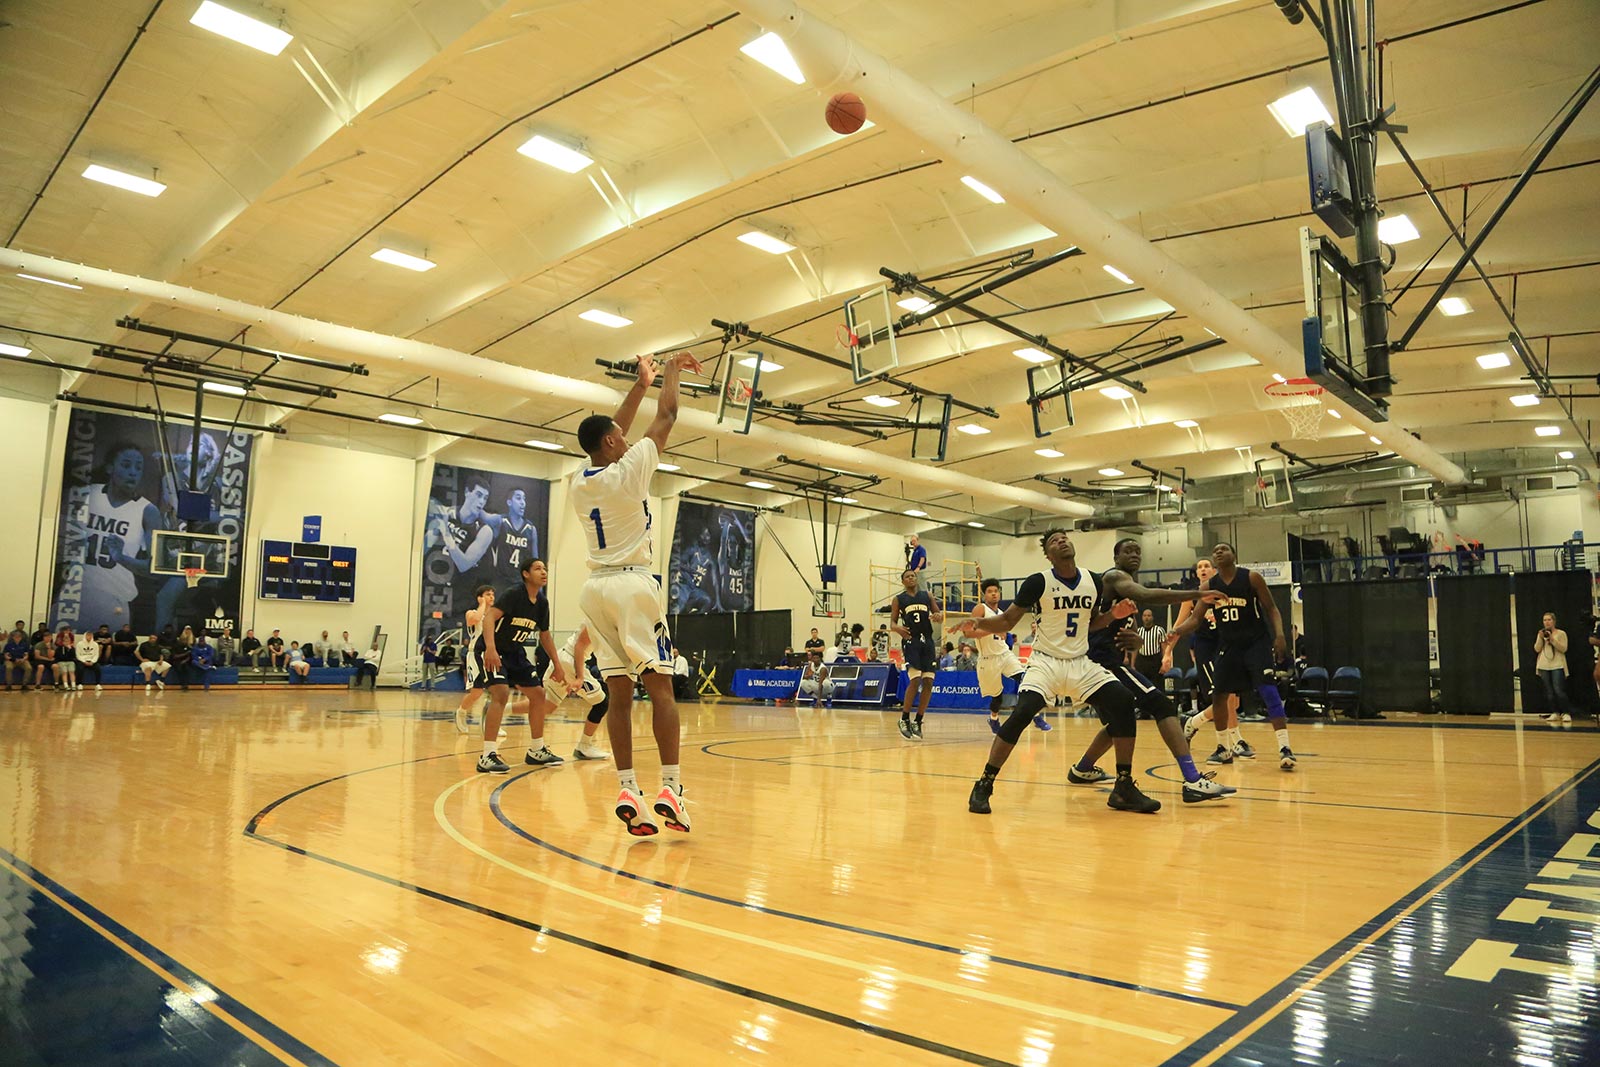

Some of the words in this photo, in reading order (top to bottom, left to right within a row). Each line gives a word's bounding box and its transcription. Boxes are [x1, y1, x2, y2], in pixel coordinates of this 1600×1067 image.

[216, 431, 248, 566] PASSION
[86, 512, 130, 537] IMG
[590, 508, 607, 550] 1
[505, 533, 528, 548] IMG
[85, 533, 117, 569] 15
[509, 548, 521, 568] 4
[729, 567, 743, 577] IMG
[729, 577, 744, 594] 45
[1053, 595, 1093, 610] IMG
[913, 612, 921, 623] 3
[1221, 608, 1239, 622] 30
[205, 618, 234, 630] IMG
[1065, 613, 1079, 637] 5
[511, 630, 528, 643] 10
[753, 679, 766, 687] IMG
[766, 680, 796, 688] ACADEMY
[941, 686, 980, 695] ACADEMY
